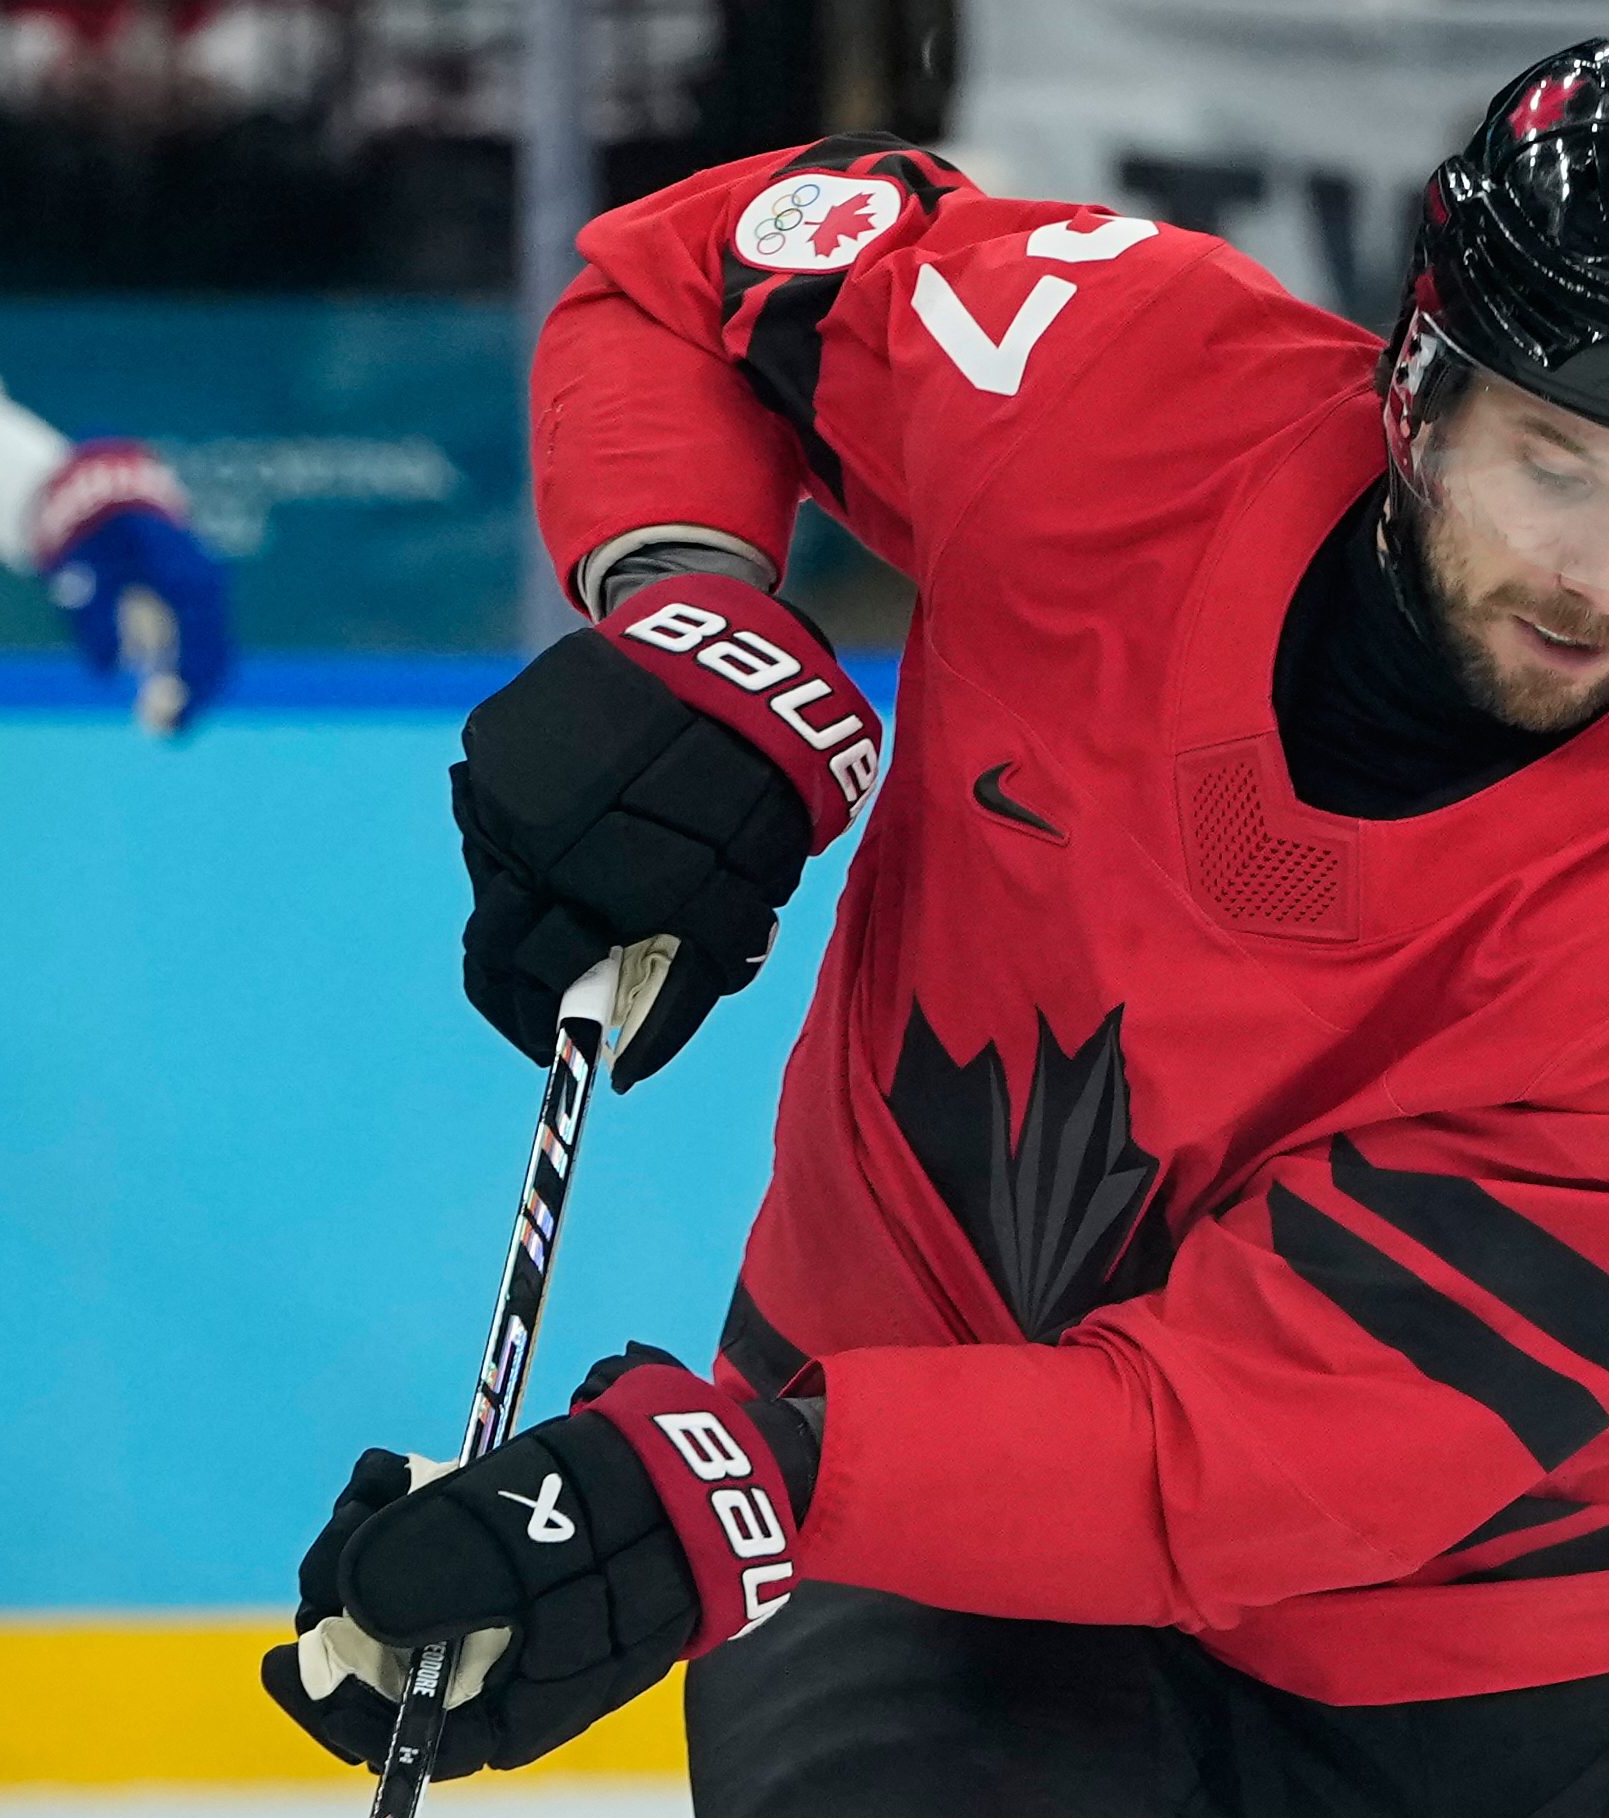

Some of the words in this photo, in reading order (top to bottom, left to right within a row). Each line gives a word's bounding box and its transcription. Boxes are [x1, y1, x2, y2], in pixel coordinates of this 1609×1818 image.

[622, 602, 880, 836] BAUE
[653, 1411, 794, 1642] BAU
[412, 1640, 448, 1699] EODORE
